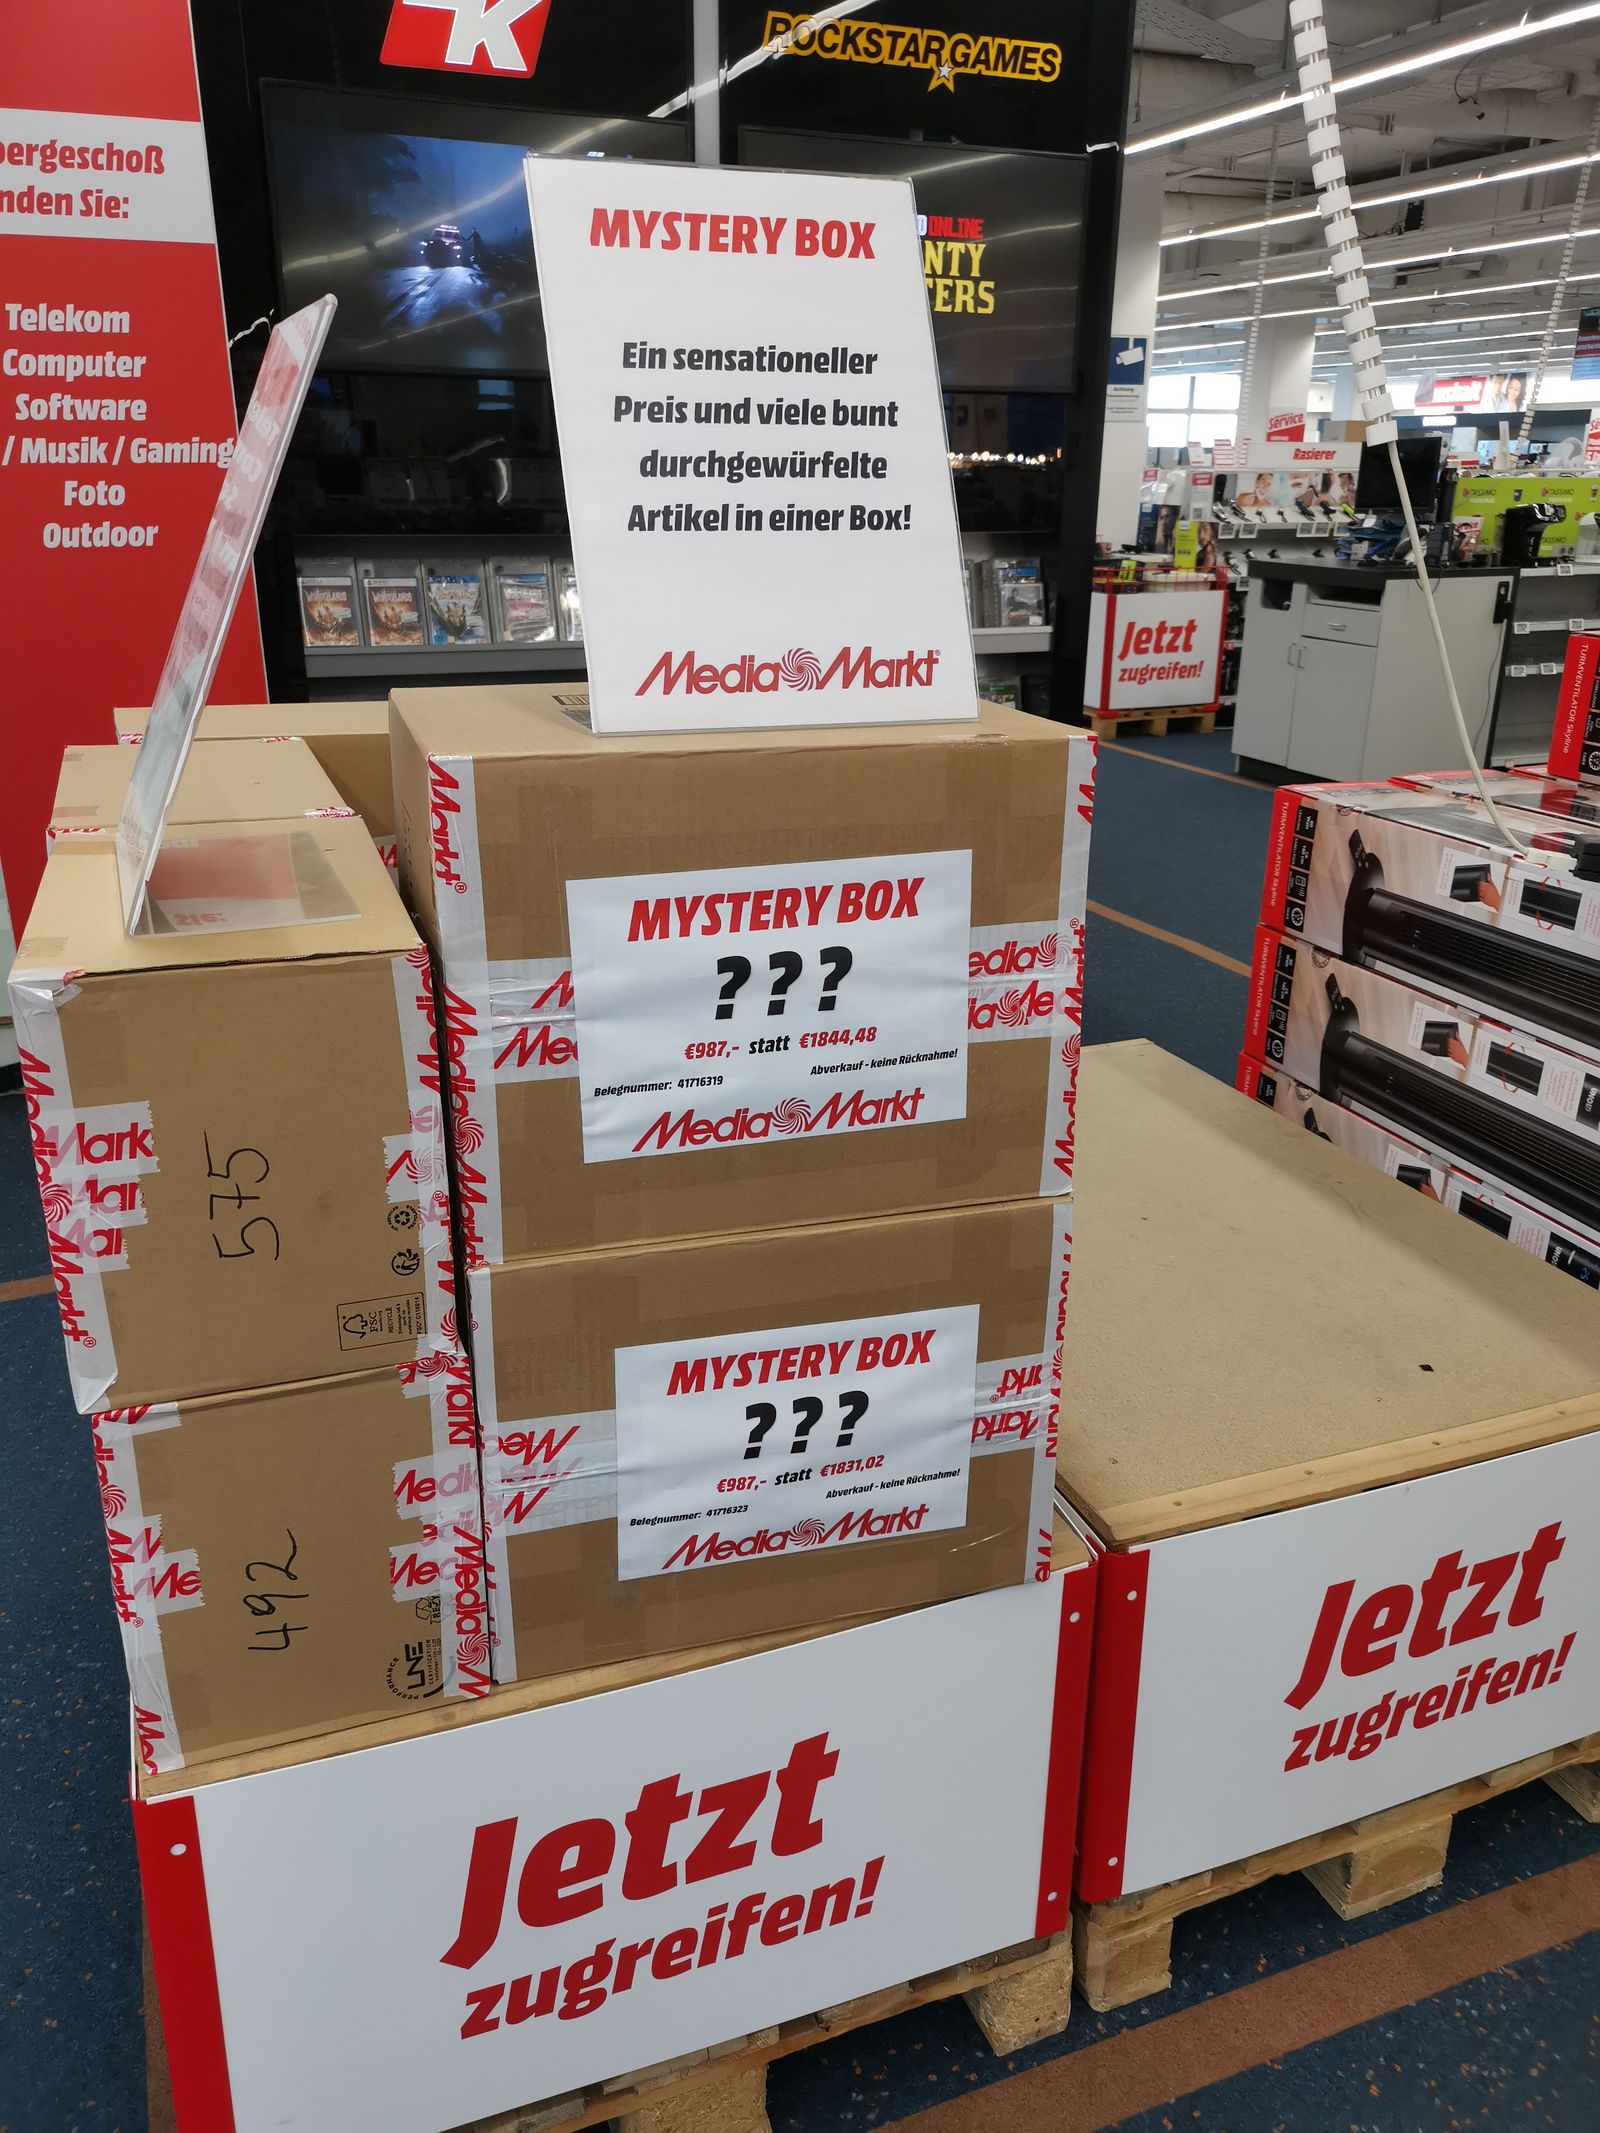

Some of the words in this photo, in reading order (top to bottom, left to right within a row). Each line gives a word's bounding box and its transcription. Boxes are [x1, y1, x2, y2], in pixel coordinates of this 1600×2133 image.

[80, 189, 128, 219] Sie:
[589, 208, 786, 255] MYSTERY
[795, 219, 875, 259] BOX
[5, 303, 129, 333] Telekom
[3, 349, 146, 382] Computer
[623, 341, 666, 369] Ein
[673, 345, 878, 374] sensationeller
[16, 393, 146, 421] Software
[614, 396, 688, 423] Preis
[695, 397, 751, 424] und
[757, 398, 826, 425] viele
[833, 399, 898, 427] bunt
[21, 437, 108, 463] Musik
[130, 437, 234, 469] Gaming
[640, 450, 887, 483] durchgewürfelte
[1293, 448, 1336, 461] Rasierer
[64, 480, 125, 506] Foto
[628, 504, 729, 531] Artikel
[736, 504, 763, 531] in
[769, 504, 844, 531] einer
[850, 505, 911, 530] Box!
[43, 521, 158, 548] Outdoor
[1118, 619, 1197, 661] Jetzt
[1119, 662, 1203, 685] zugreifen!
[628, 885, 832, 942] MYSTERY
[837, 878, 925, 923] BOX
[685, 1041, 739, 1059] €987,-
[749, 1035, 790, 1054] statt
[800, 1028, 876, 1048] €1844,48
[811, 1061, 864, 1075] Abverkauf
[871, 1058, 897, 1068] keine
[899, 1049, 958, 1064] Rücknahme!
[594, 1082, 672, 1096] Belegnummer:
[678, 1076, 723, 1088] 41716319
[204, 1130, 279, 1261] 575
[369, 1311, 379, 1333] FSC
[667, 1341, 852, 1396] MYSTERY
[856, 1331, 934, 1372] BOX
[717, 1477, 766, 1492] €987,-
[775, 1468, 812, 1485] statt
[821, 1455, 884, 1476] €1831,02
[826, 1483, 874, 1498] Abverkauf
[880, 1479, 905, 1489] keine
[906, 1469, 960, 1484] Rücknahme!
[630, 1512, 701, 1526] Belegnummer:
[706, 1505, 748, 1516] 41716323
[1284, 1522, 1567, 1710] Jetzt
[1284, 1631, 1577, 1772] zugreifen!
[441, 1733, 840, 1969] Jetzt
[460, 1856, 884, 2038] zugreifen!
